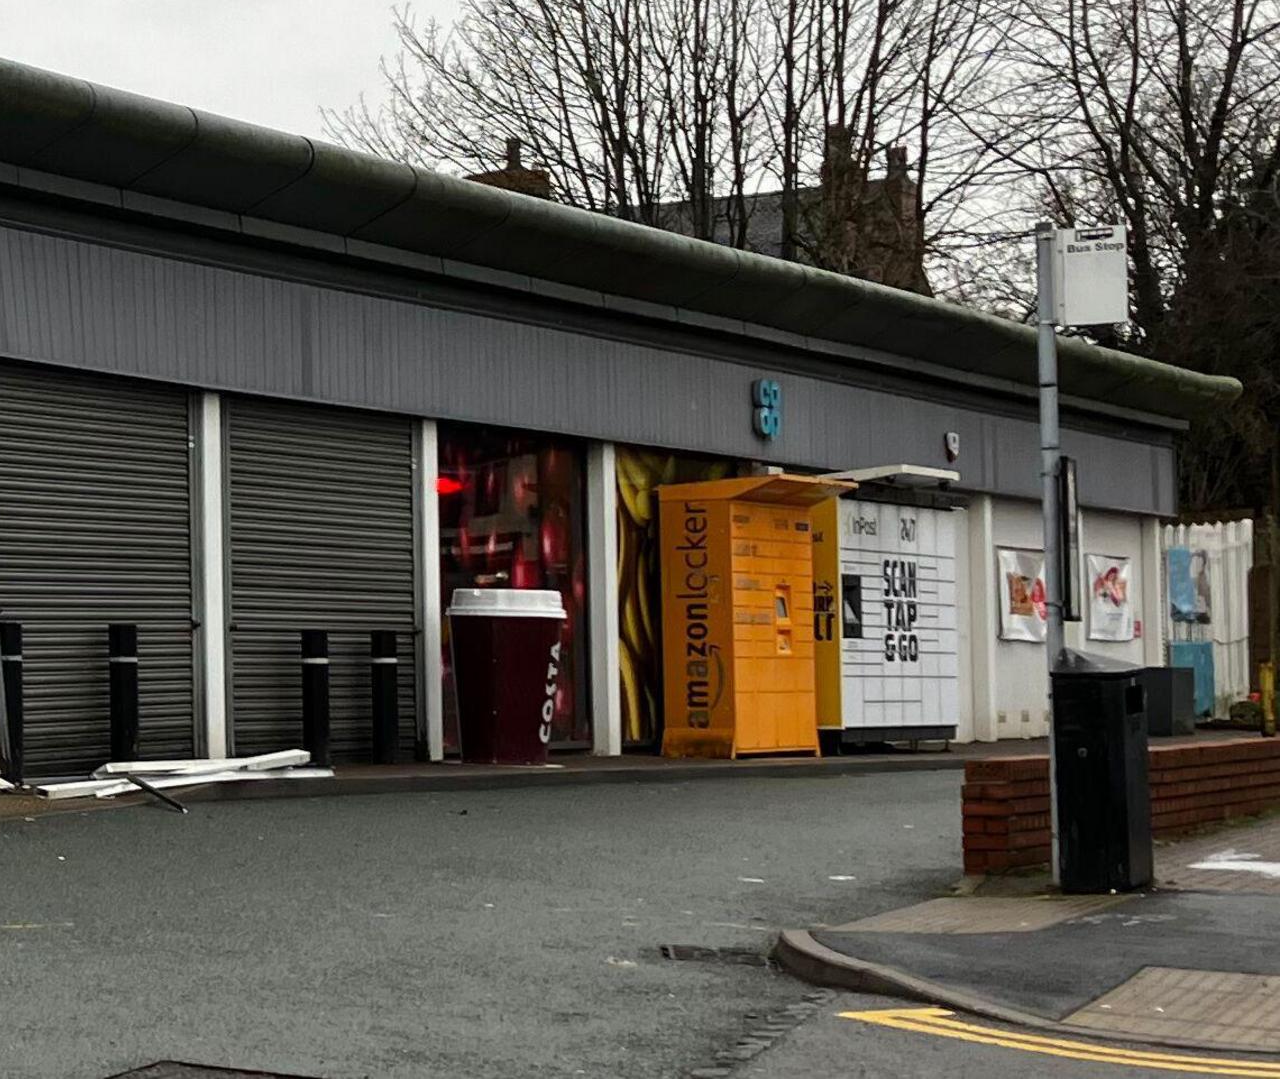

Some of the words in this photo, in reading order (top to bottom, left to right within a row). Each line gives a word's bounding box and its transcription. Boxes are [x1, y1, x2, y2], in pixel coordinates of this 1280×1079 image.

[1066, 243, 1090, 254] Bus
[1095, 241, 1125, 253] Stop
[883, 559, 917, 598] SCAN
[883, 600, 918, 632] TAP
